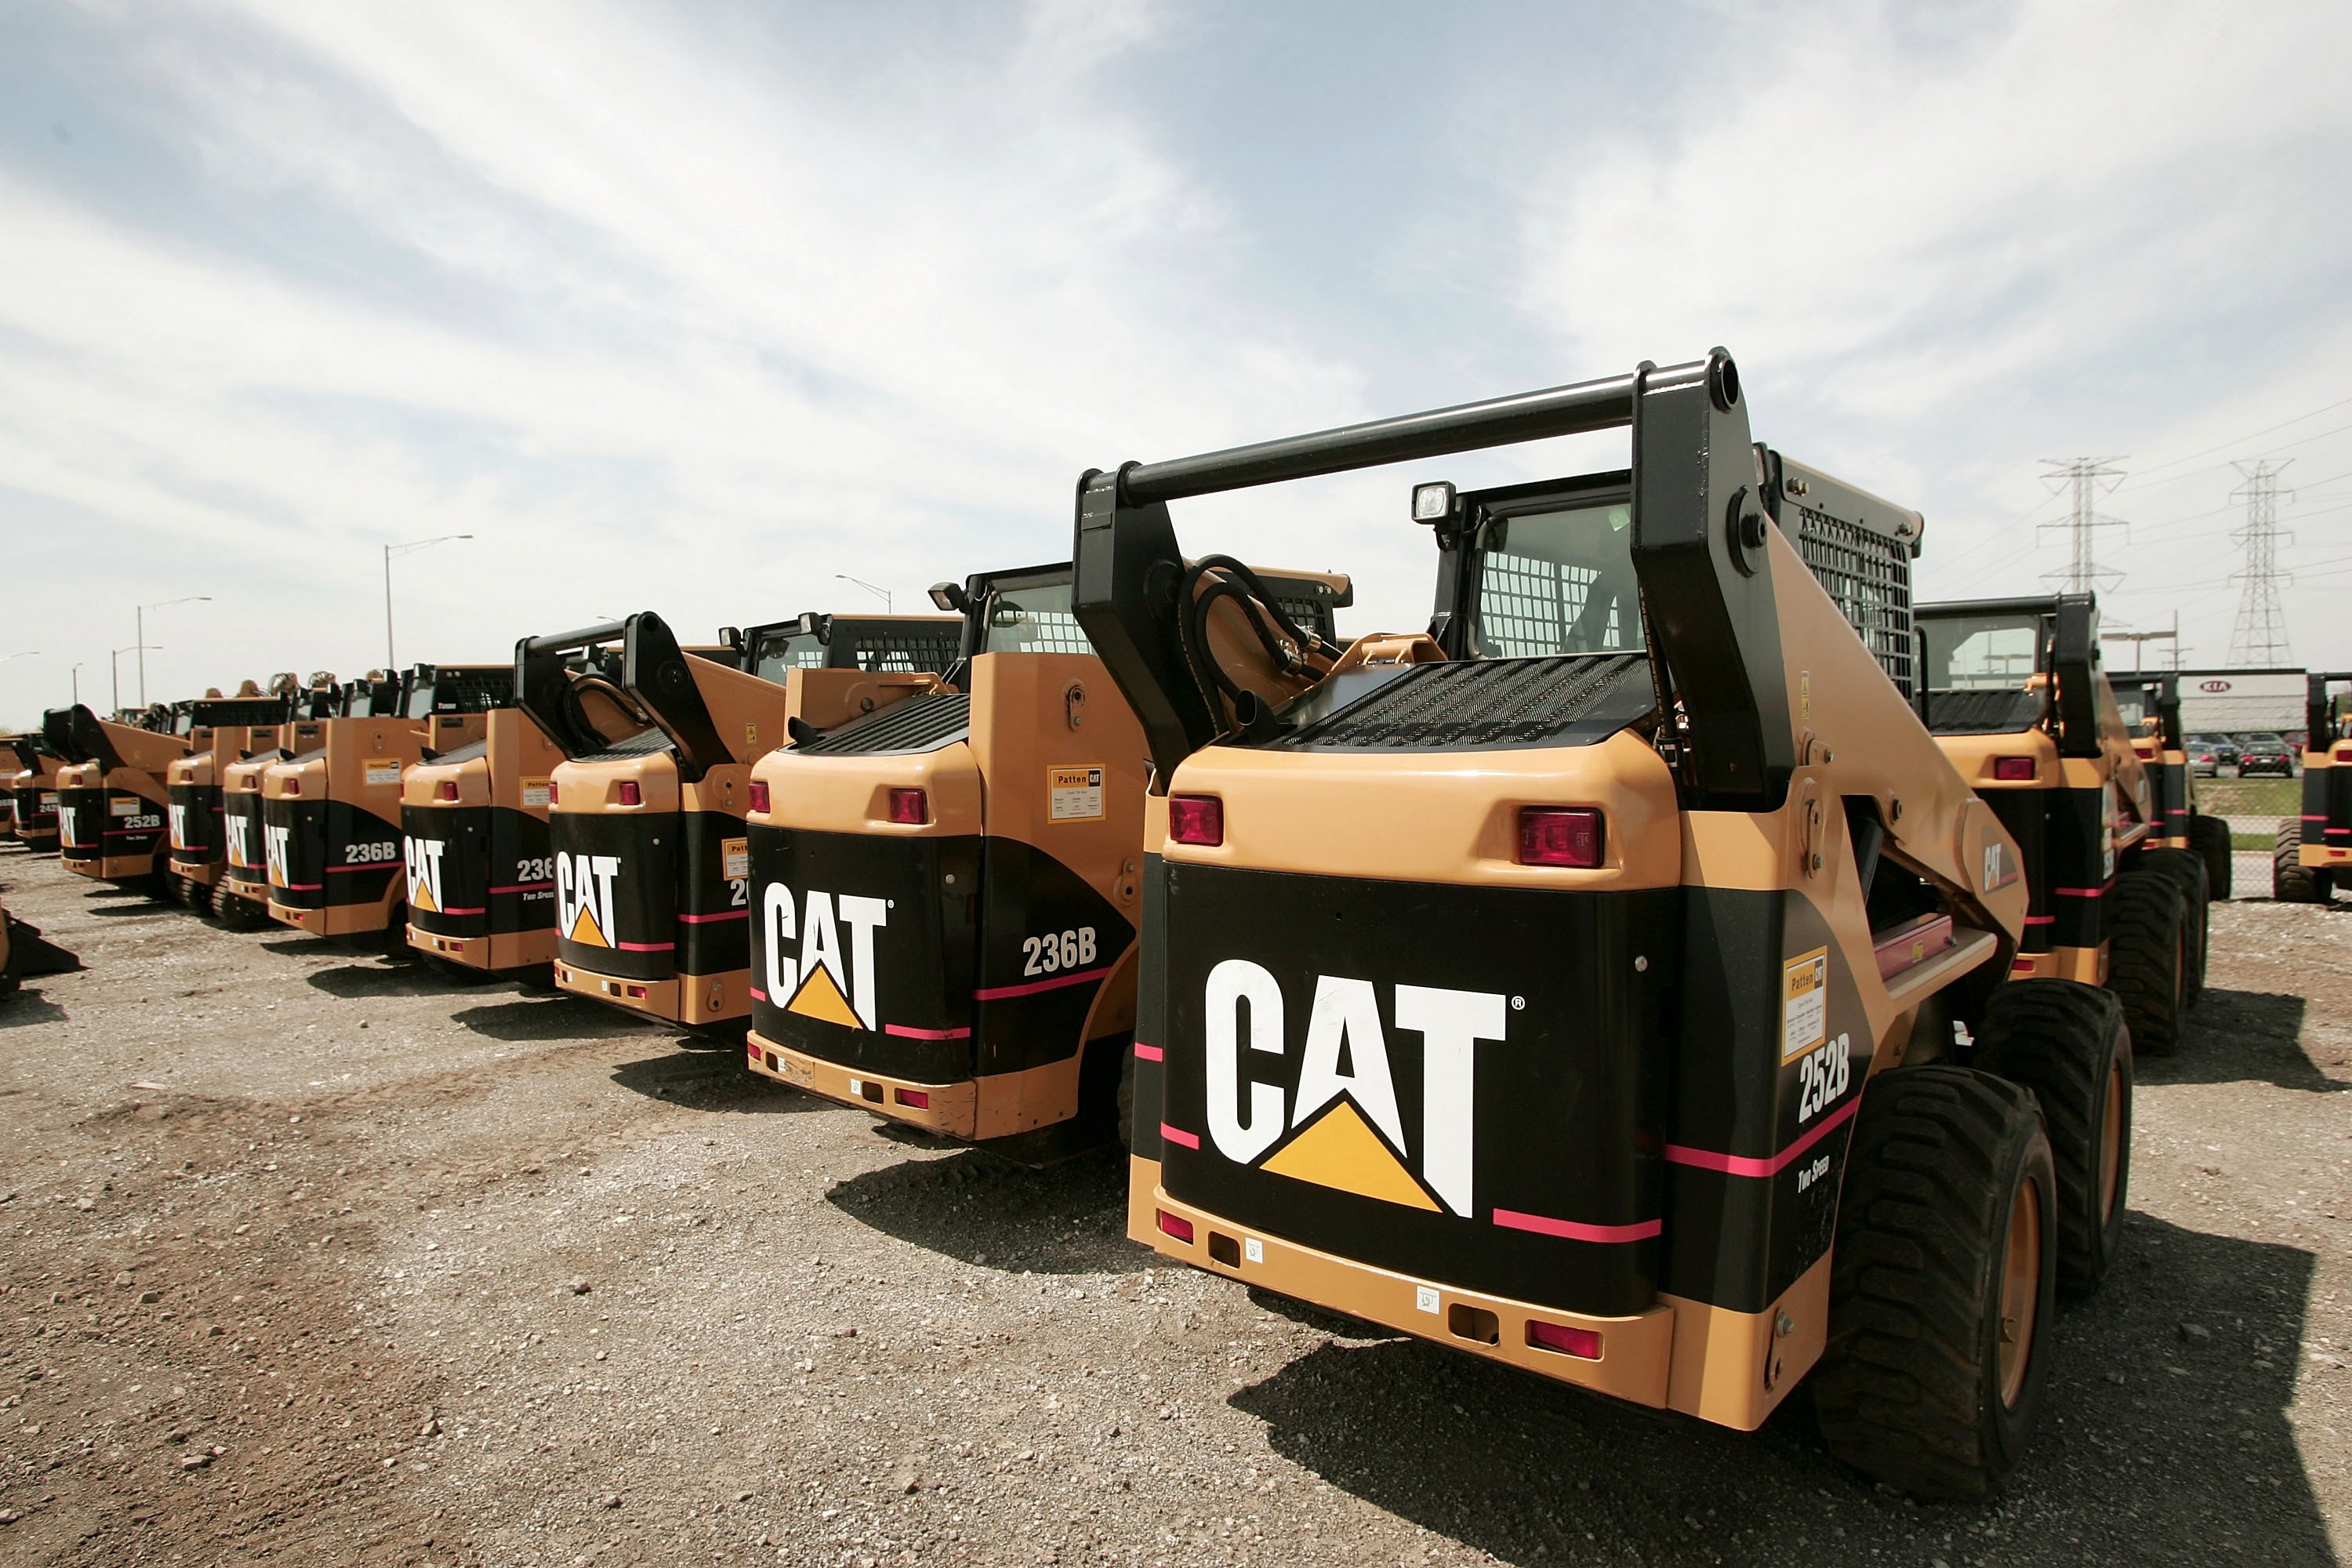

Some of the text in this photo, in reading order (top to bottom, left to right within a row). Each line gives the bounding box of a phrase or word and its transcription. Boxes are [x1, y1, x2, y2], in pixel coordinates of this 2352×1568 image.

[2202, 681, 2228, 691] KIA
[1090, 774, 1099, 782] CAT
[39, 804, 57, 813] 242
[124, 815, 160, 829] 252B
[346, 842, 395, 863] 236B
[517, 857, 553, 882] 236
[1984, 843, 2002, 891] CAT
[405, 835, 443, 913] CAT
[557, 851, 618, 949] CAT
[764, 882, 887, 1032] CAT
[1022, 927, 1096, 977] 236B
[1791, 973, 1813, 991] Patten
[1206, 959, 1506, 1218] CAT
[1798, 1033, 1849, 1123] 252B
